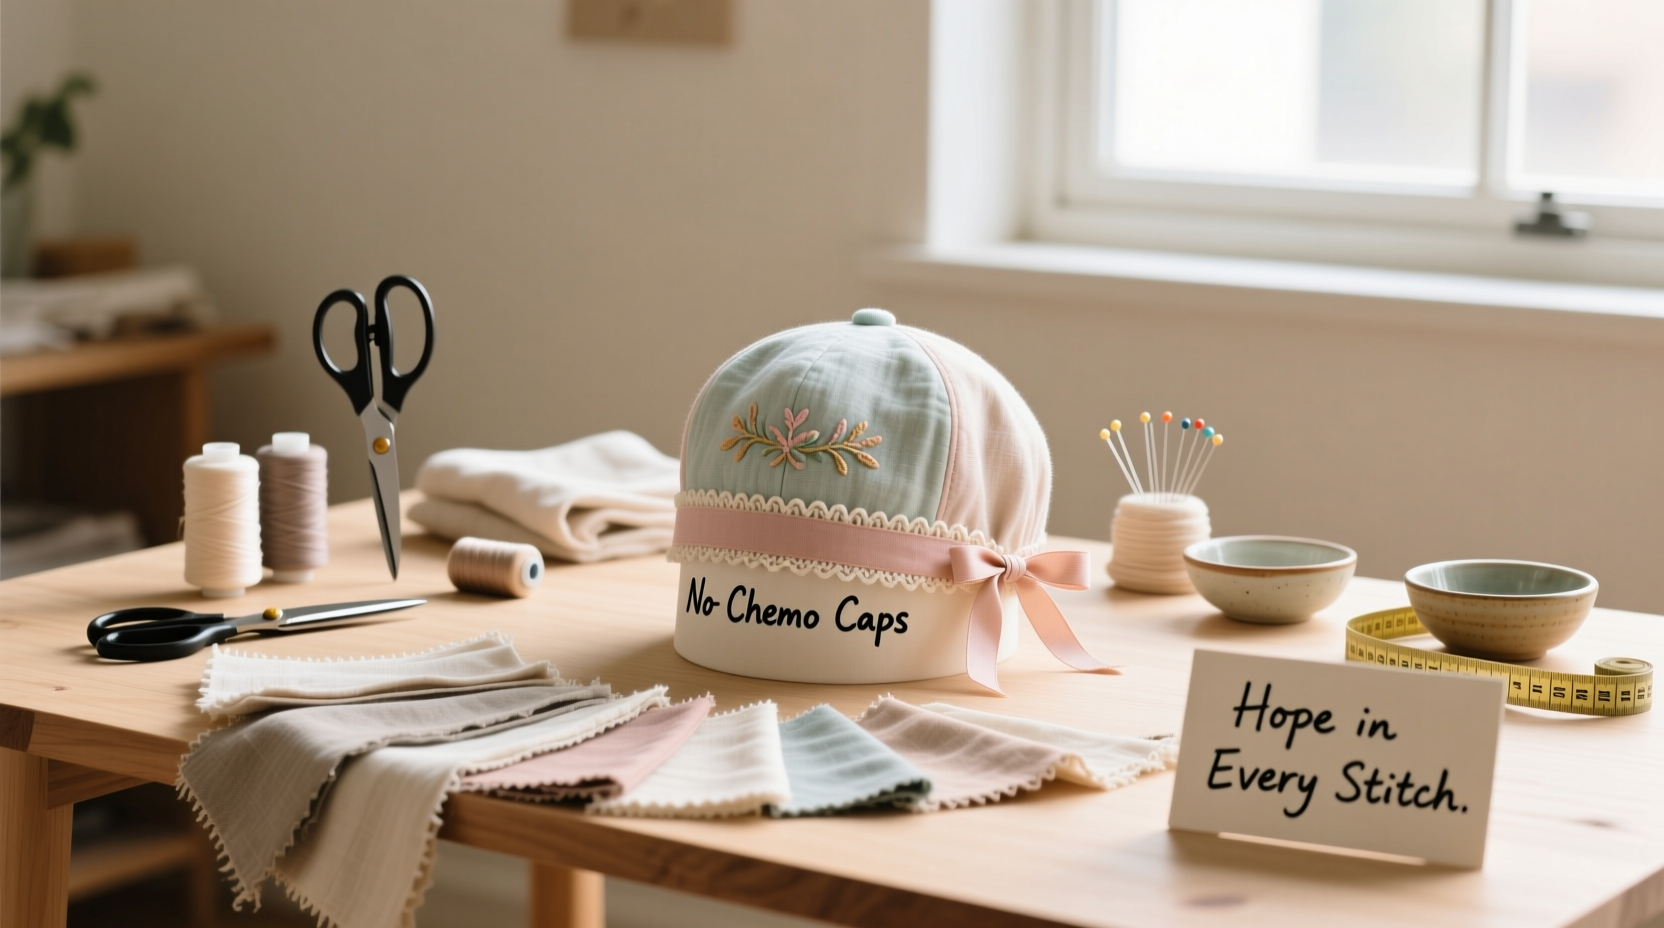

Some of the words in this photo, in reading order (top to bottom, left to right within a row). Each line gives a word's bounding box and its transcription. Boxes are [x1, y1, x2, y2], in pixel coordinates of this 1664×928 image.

[726, 584, 820, 630] Chemo
[834, 594, 909, 648] Caps
[1232, 681, 1336, 750] Hope
[1355, 707, 1398, 741] in
[1207, 747, 1318, 819] Every
[1334, 760, 1469, 814] Stitch.
